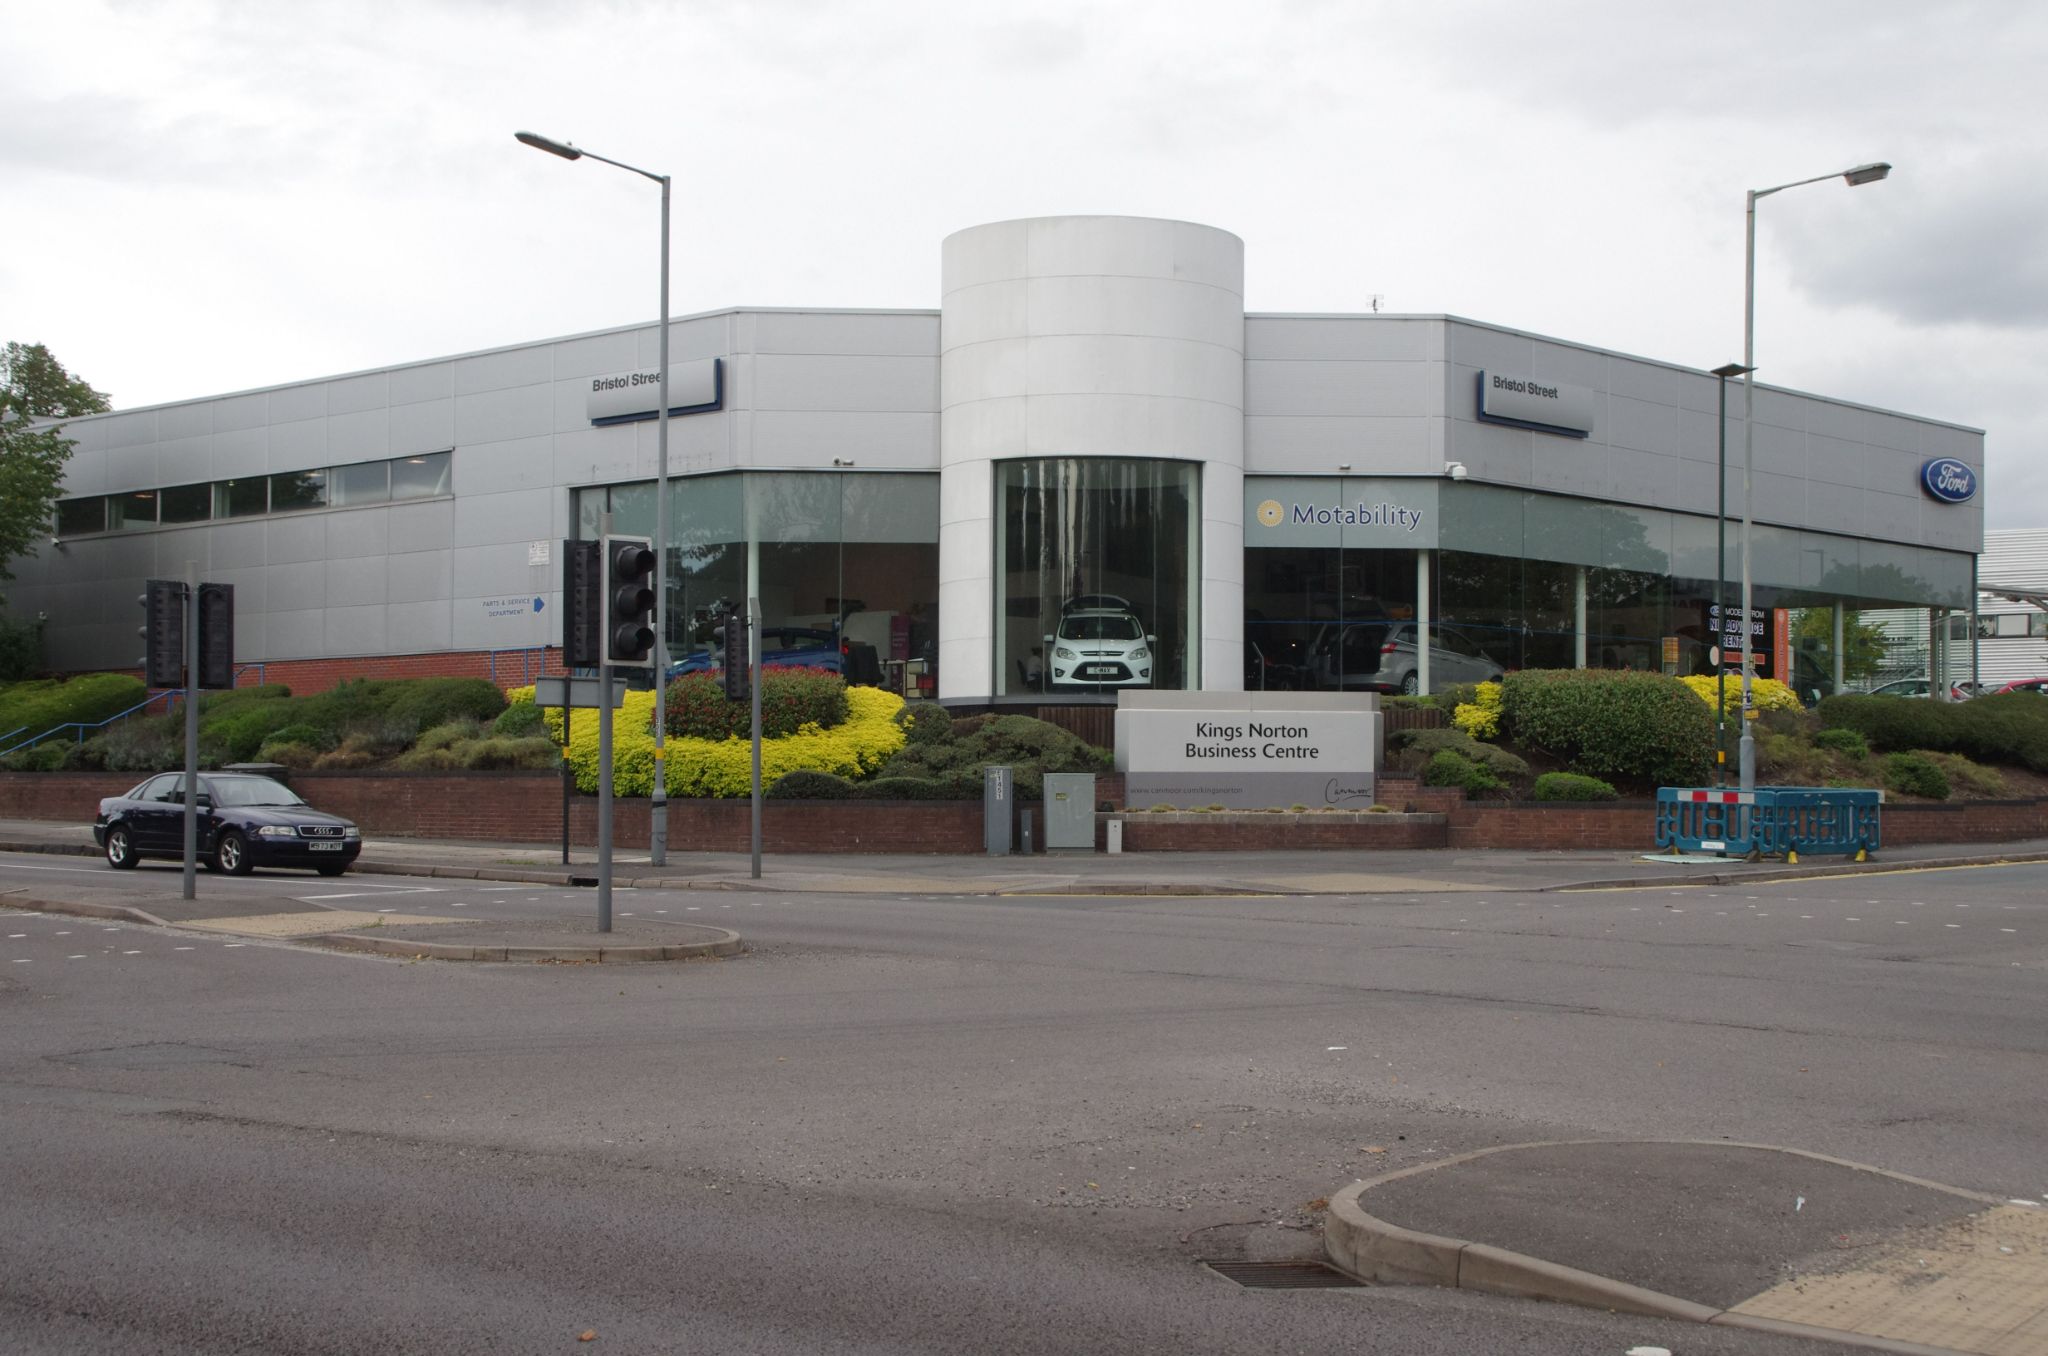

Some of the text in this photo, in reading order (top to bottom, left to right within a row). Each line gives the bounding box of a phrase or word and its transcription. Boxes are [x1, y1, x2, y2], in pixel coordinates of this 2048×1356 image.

[593, 372, 662, 392] Bristol Stree
[1493, 375, 1558, 399] Bristol Street
[1937, 463, 1969, 494] Ford
[1292, 502, 1422, 532] Motability
[488, 608, 524, 617] DEPARTMENT
[1196, 722, 1308, 741] Kings Norton
[1185, 743, 1319, 759] Business Centre
